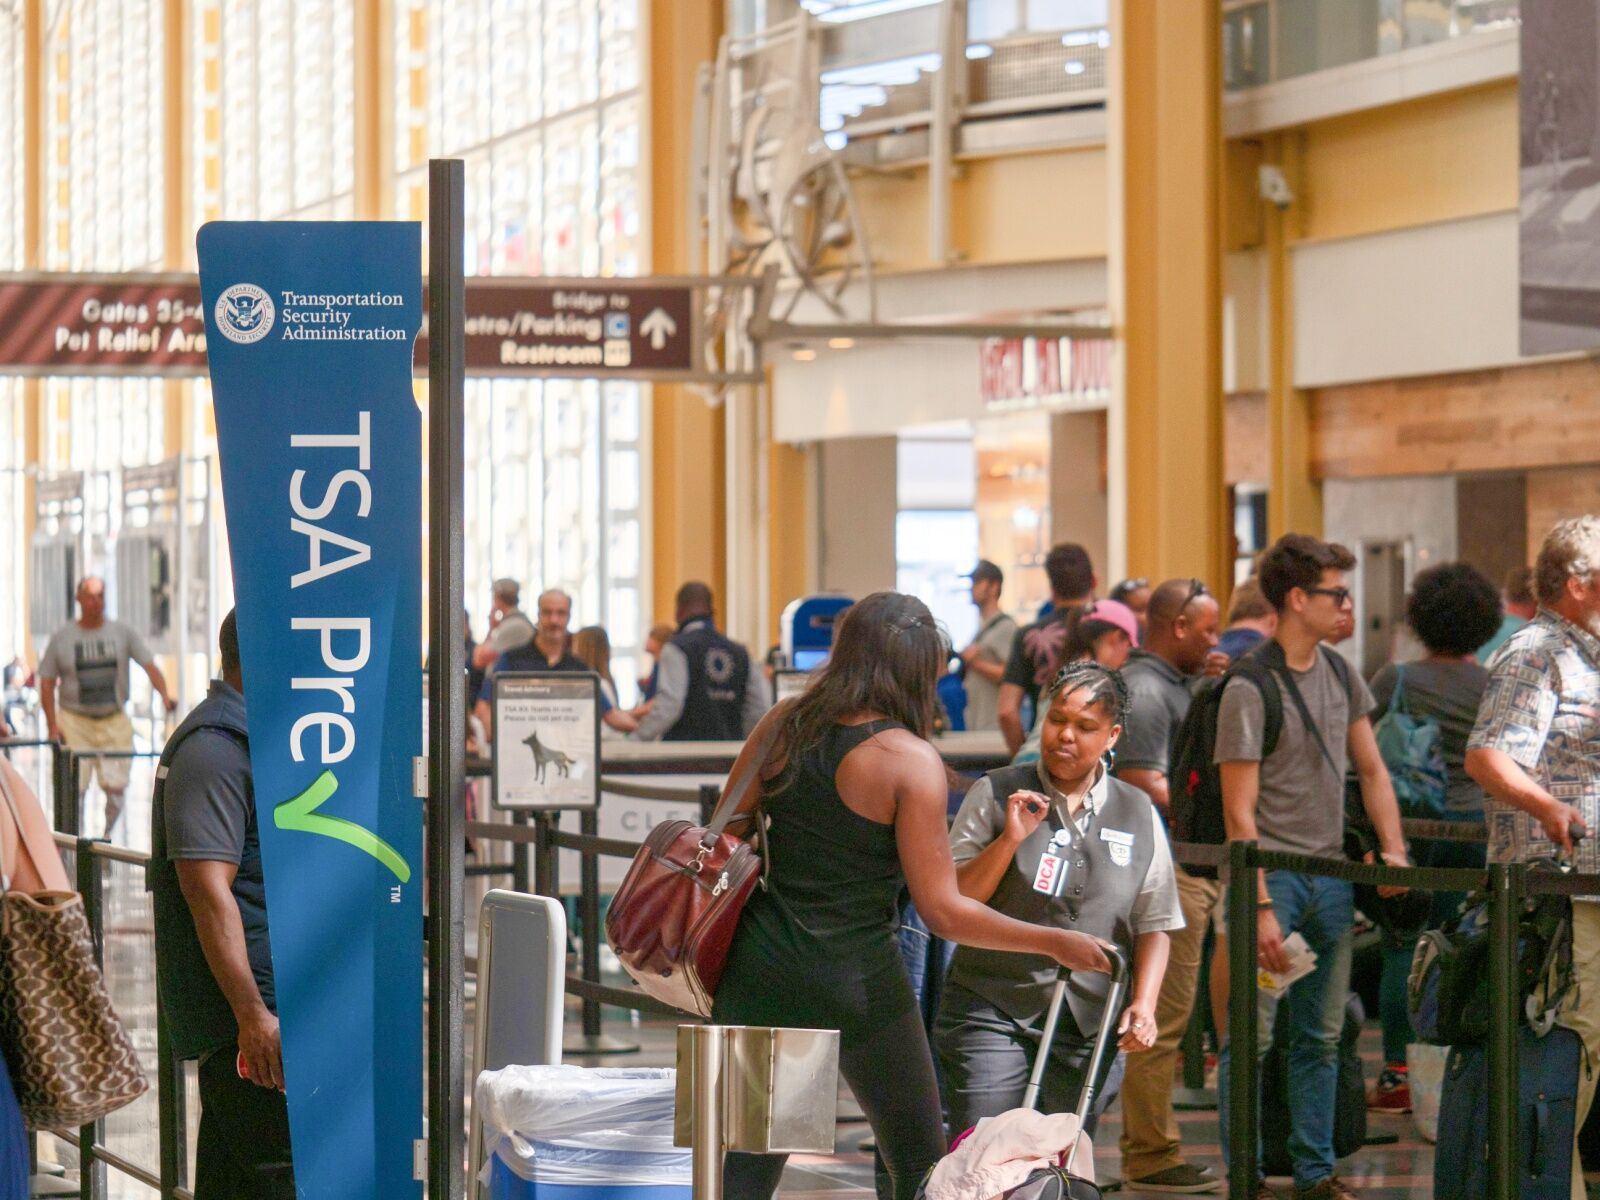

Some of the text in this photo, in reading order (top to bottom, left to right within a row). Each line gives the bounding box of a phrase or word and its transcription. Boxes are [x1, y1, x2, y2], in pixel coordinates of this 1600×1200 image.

[227, 286, 267, 300] DEPARTMENT
[281, 290, 404, 310] Transportation
[552, 290, 606, 312] Bridge
[82, 298, 149, 323] Gates
[282, 309, 351, 327] Security
[55, 326, 90, 351] Pet
[98, 326, 161, 351] Relief
[218, 315, 271, 341] HOMELAND SECURITY
[281, 325, 407, 340] Administration
[289, 411, 372, 764] TSA Pre
[1037, 857, 1056, 891] DCA
